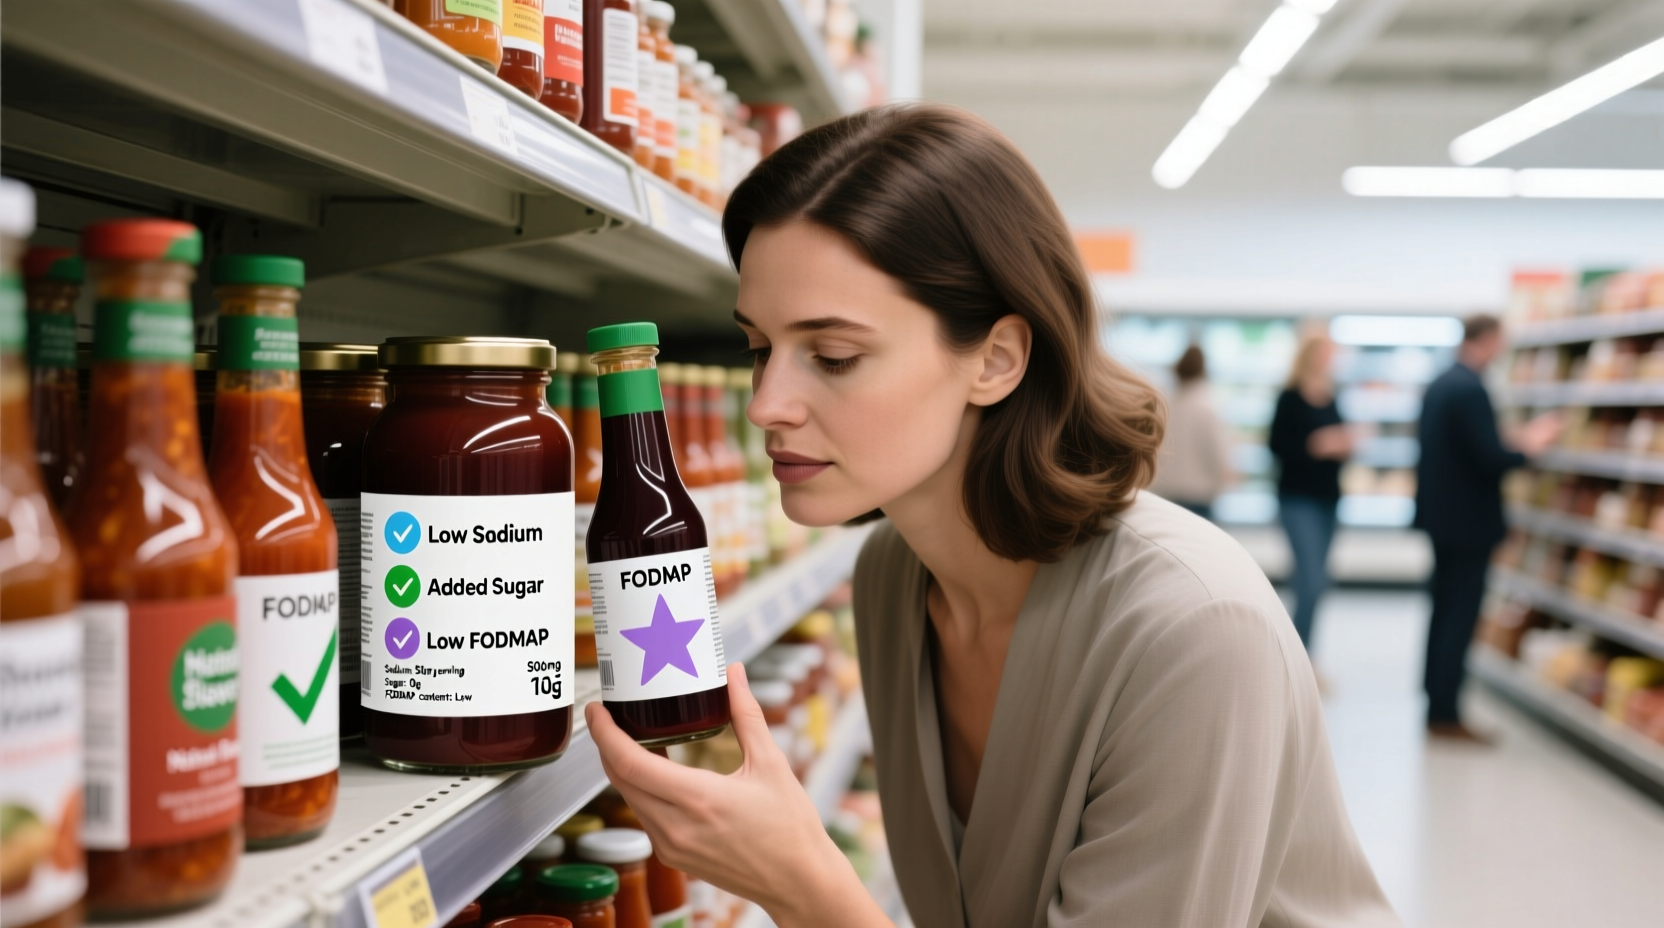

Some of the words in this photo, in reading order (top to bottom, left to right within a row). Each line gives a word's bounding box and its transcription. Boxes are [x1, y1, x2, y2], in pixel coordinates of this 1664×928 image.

[428, 525, 468, 544] Low
[472, 523, 543, 544] Sodium
[427, 577, 488, 596] Added
[492, 577, 545, 600] Sugar
[427, 631, 465, 650] Low
[469, 628, 549, 650] FODMAP
